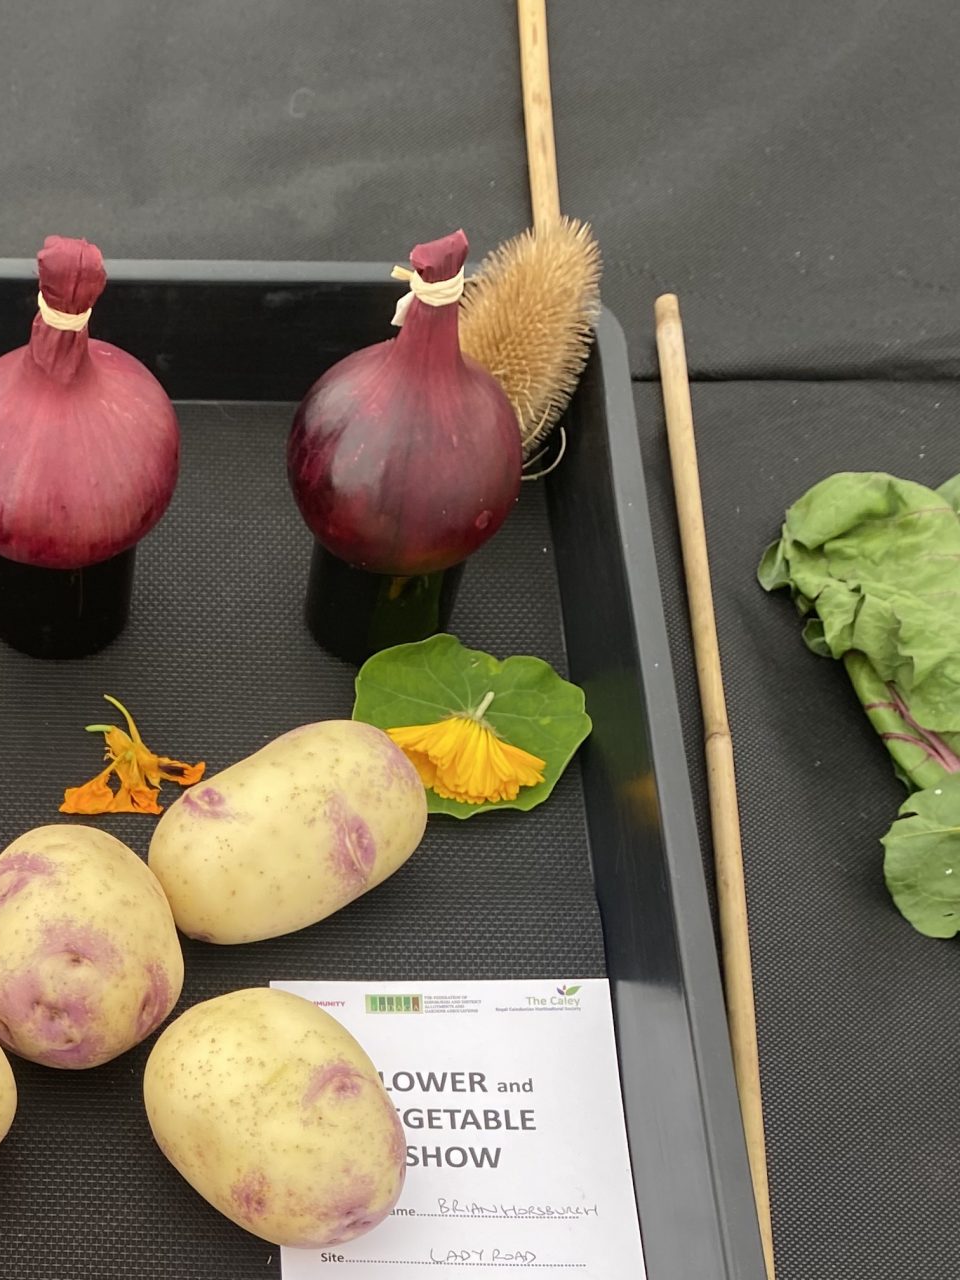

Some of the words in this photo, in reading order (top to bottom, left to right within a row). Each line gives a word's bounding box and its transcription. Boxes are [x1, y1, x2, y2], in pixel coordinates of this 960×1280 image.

[526, 996, 548, 1007] The
[550, 996, 581, 1007] Caley
[378, 1071, 488, 1093] LOWER
[497, 1078, 533, 1093] and
[396, 1108, 536, 1131] GETABLE
[406, 1145, 501, 1168] SHOW
[390, 1208, 416, 1217] ame
[438, 1198, 498, 1215] BRIAN
[430, 1248, 485, 1264] LADY
[492, 1248, 536, 1264] ROAD
